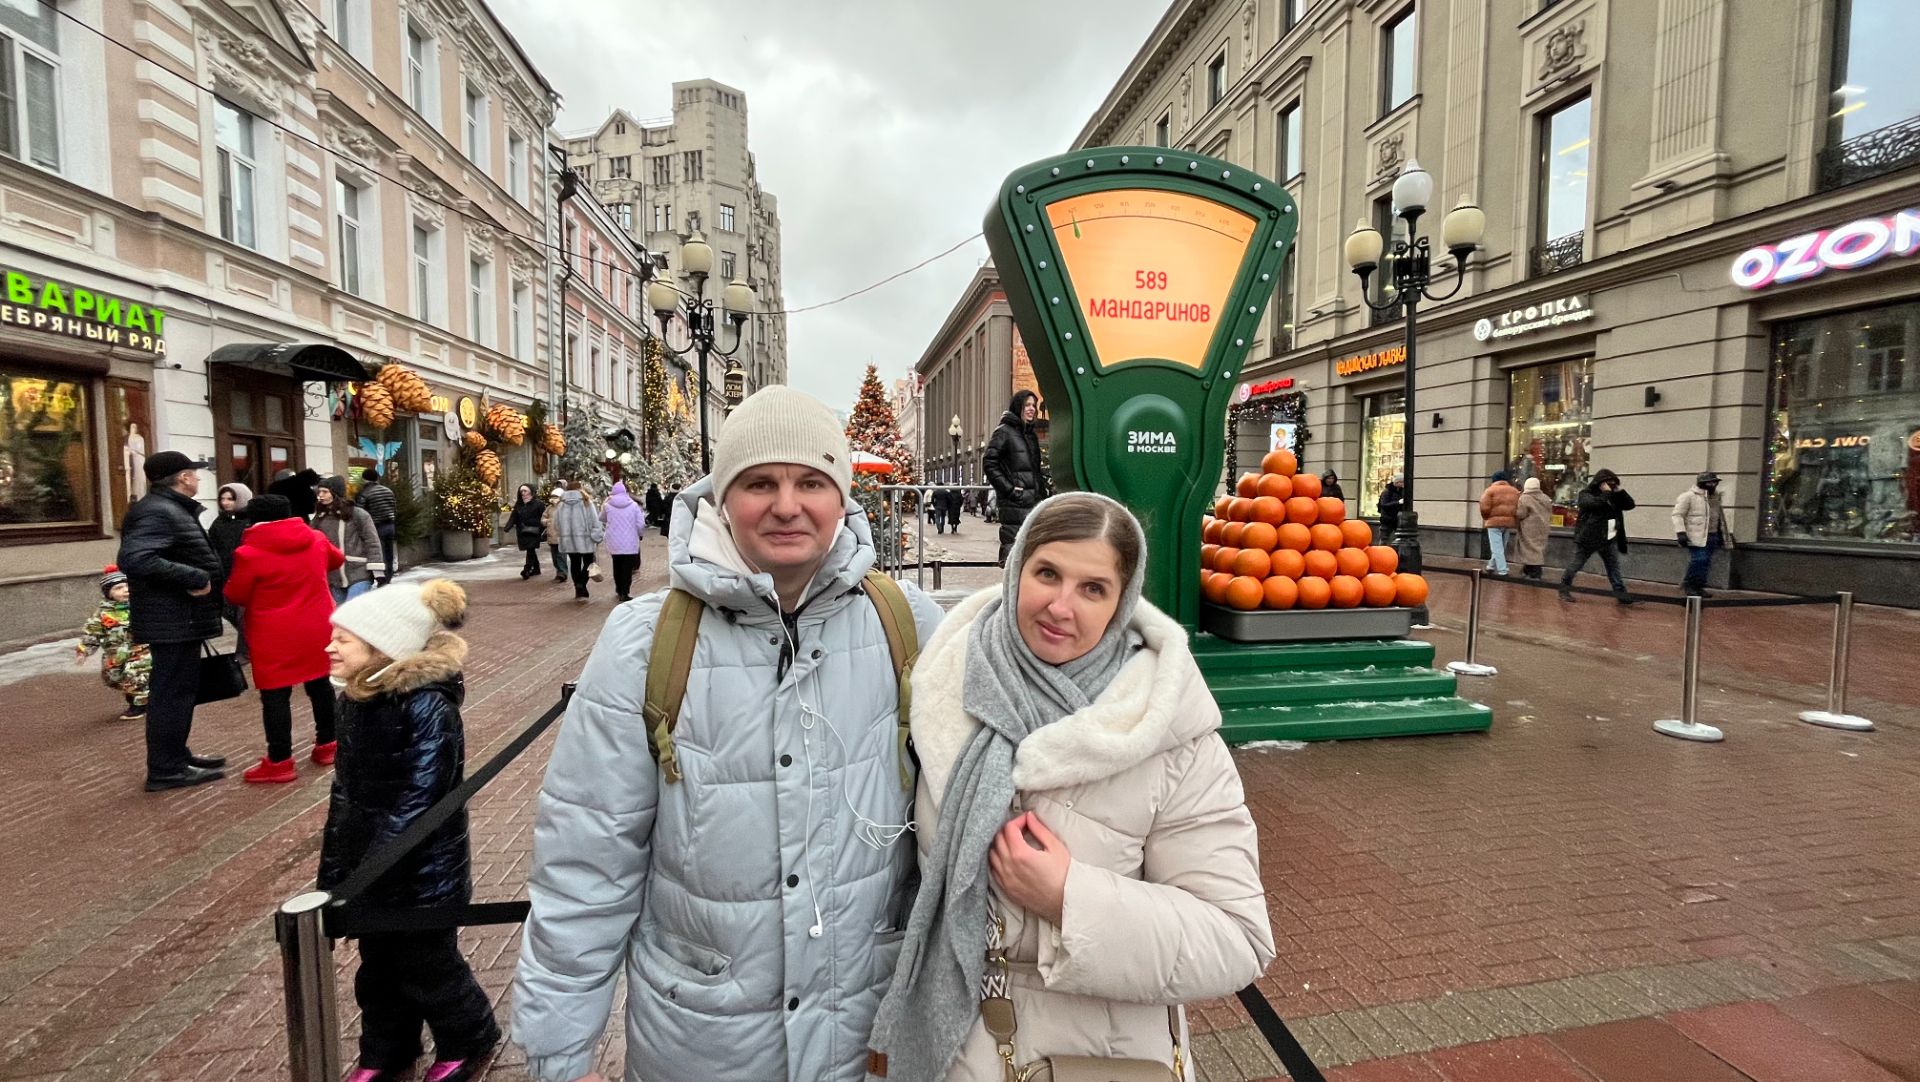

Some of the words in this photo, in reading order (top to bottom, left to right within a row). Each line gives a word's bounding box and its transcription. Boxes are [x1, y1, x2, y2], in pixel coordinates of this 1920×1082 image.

[1135, 269, 1168, 290] 589
[7, 271, 165, 335] ВАРИАТ
[1501, 296, 1581, 326] КРОПКА
[1, 304, 119, 343] ЕБРЯНЫЙ
[128, 331, 167, 356] РЯД
[1127, 430, 1177, 445] ЗИМА
[1127, 445, 1135, 453] В
[1136, 445, 1177, 453] МОСКВЕ
